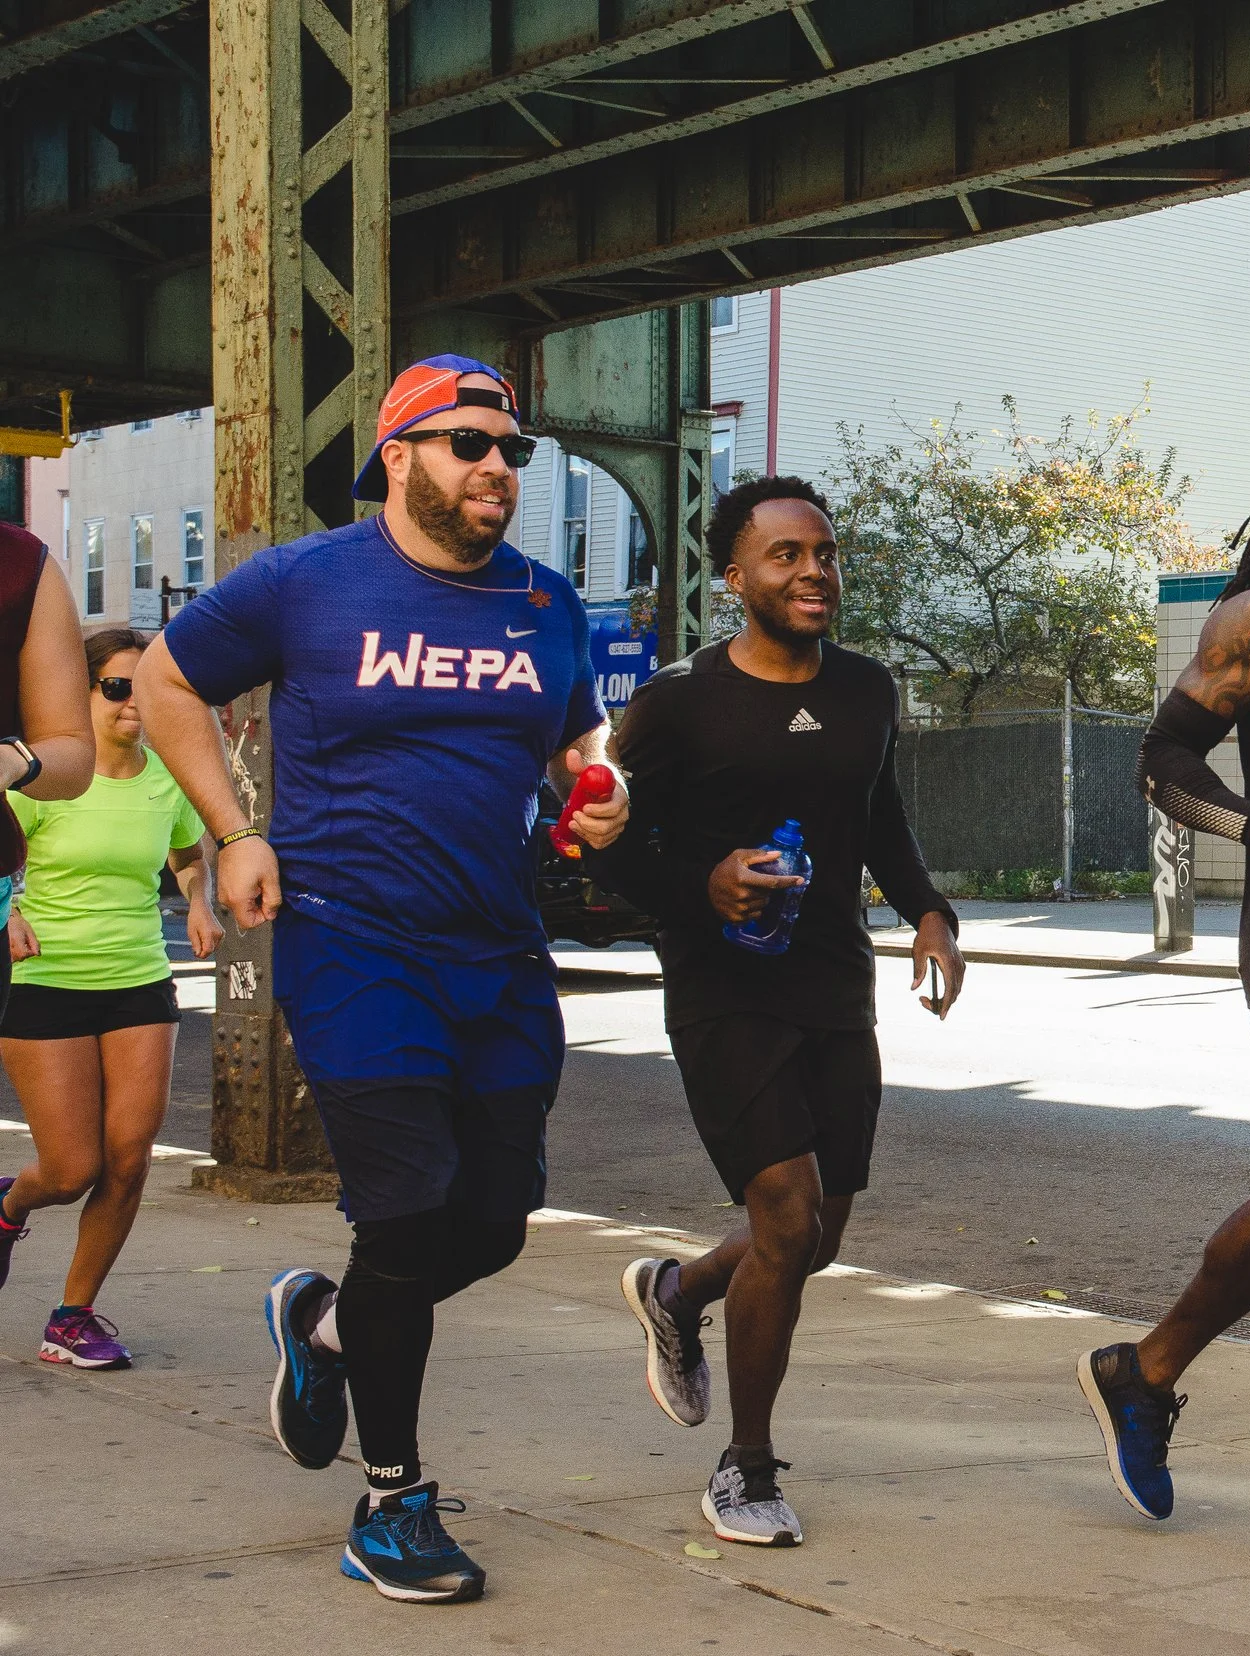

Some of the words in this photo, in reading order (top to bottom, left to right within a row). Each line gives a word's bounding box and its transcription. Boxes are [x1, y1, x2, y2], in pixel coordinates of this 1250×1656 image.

[357, 631, 542, 693] WEPA
[789, 722, 822, 732] adidas
[371, 1465, 403, 1478] PRO
